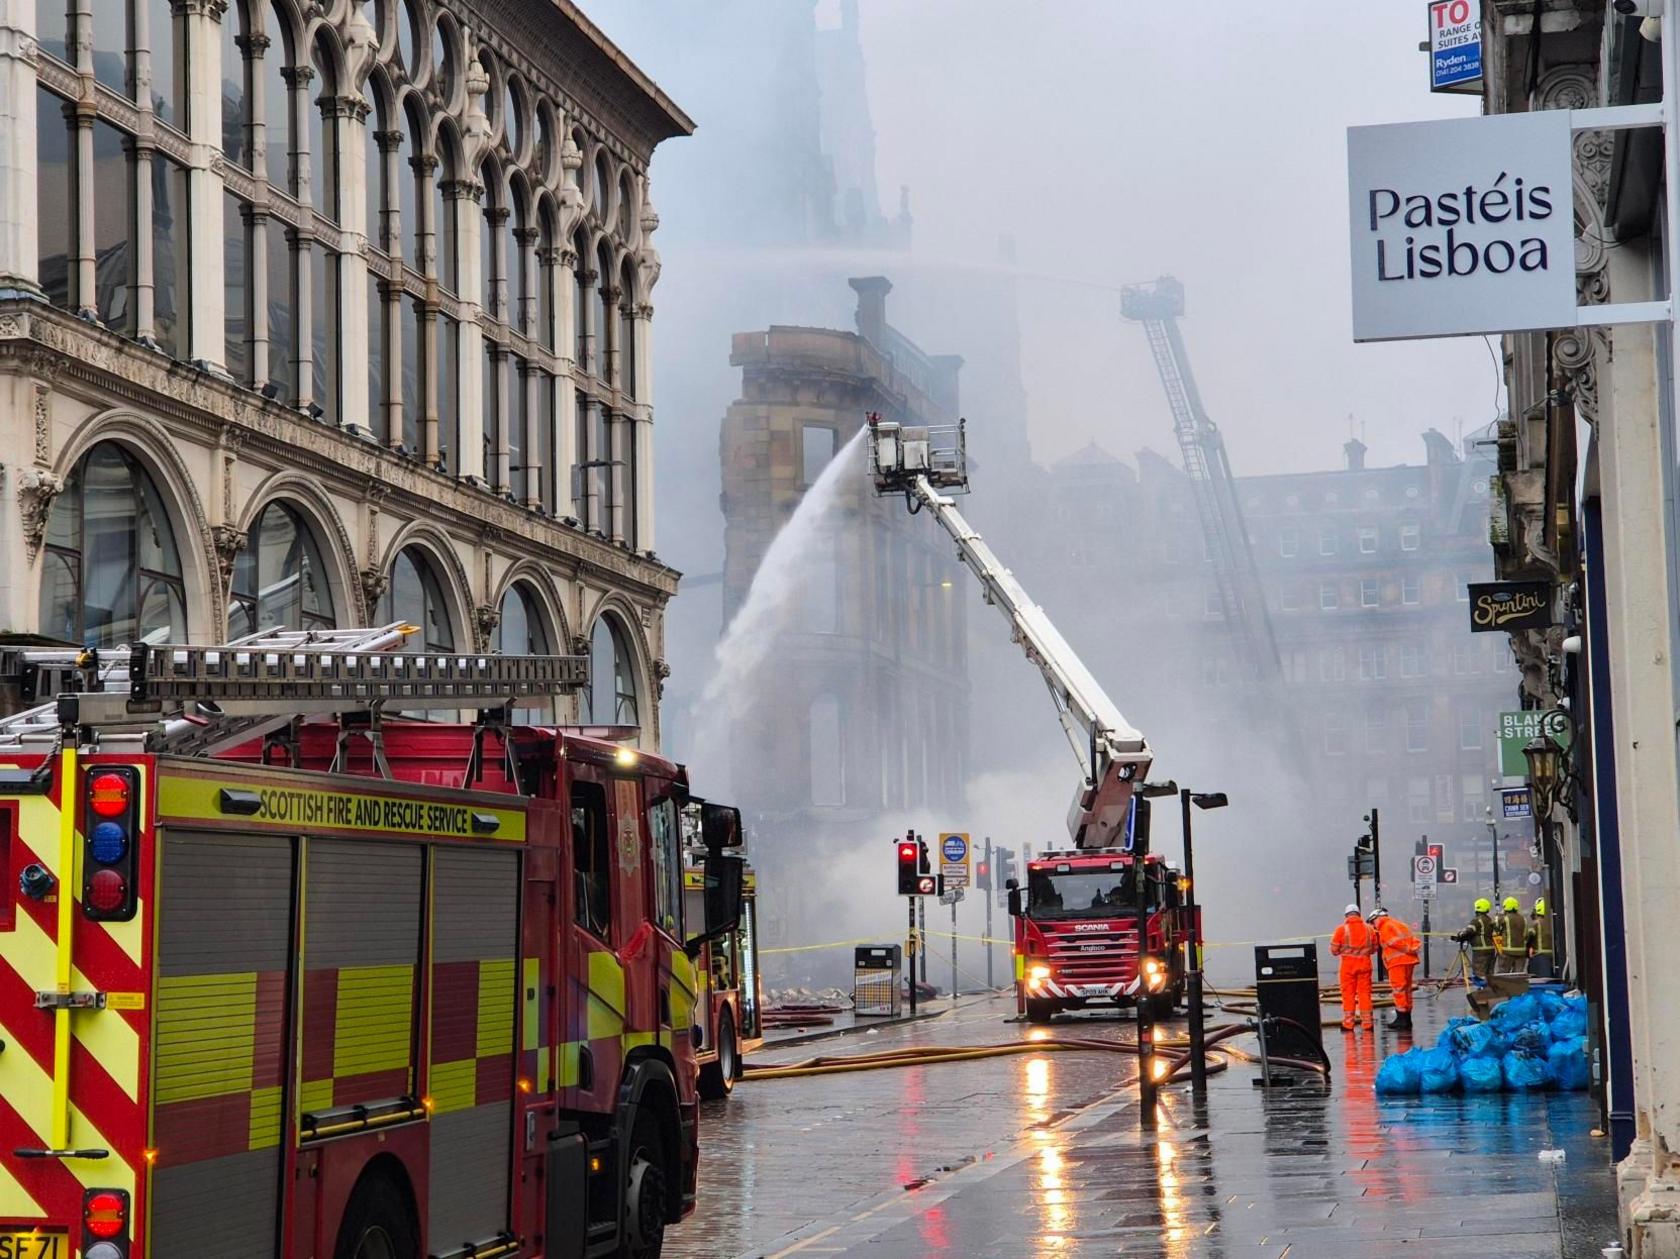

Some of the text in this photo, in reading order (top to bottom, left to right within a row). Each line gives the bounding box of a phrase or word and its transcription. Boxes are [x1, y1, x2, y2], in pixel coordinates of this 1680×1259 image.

[1433, 0, 1469, 28] TO
[1439, 34, 1469, 49] SUITES
[1440, 23, 1471, 38] RANGE
[1436, 55, 1466, 68] Ryden
[1369, 172, 1553, 231] Pastéis
[1377, 227, 1548, 281] Lisboa
[1474, 591, 1546, 627] Spuntini
[259, 789, 468, 833] SCOTTISH FIRE AND RESCUE SERVICE
[1074, 923, 1109, 931] SCANIA
